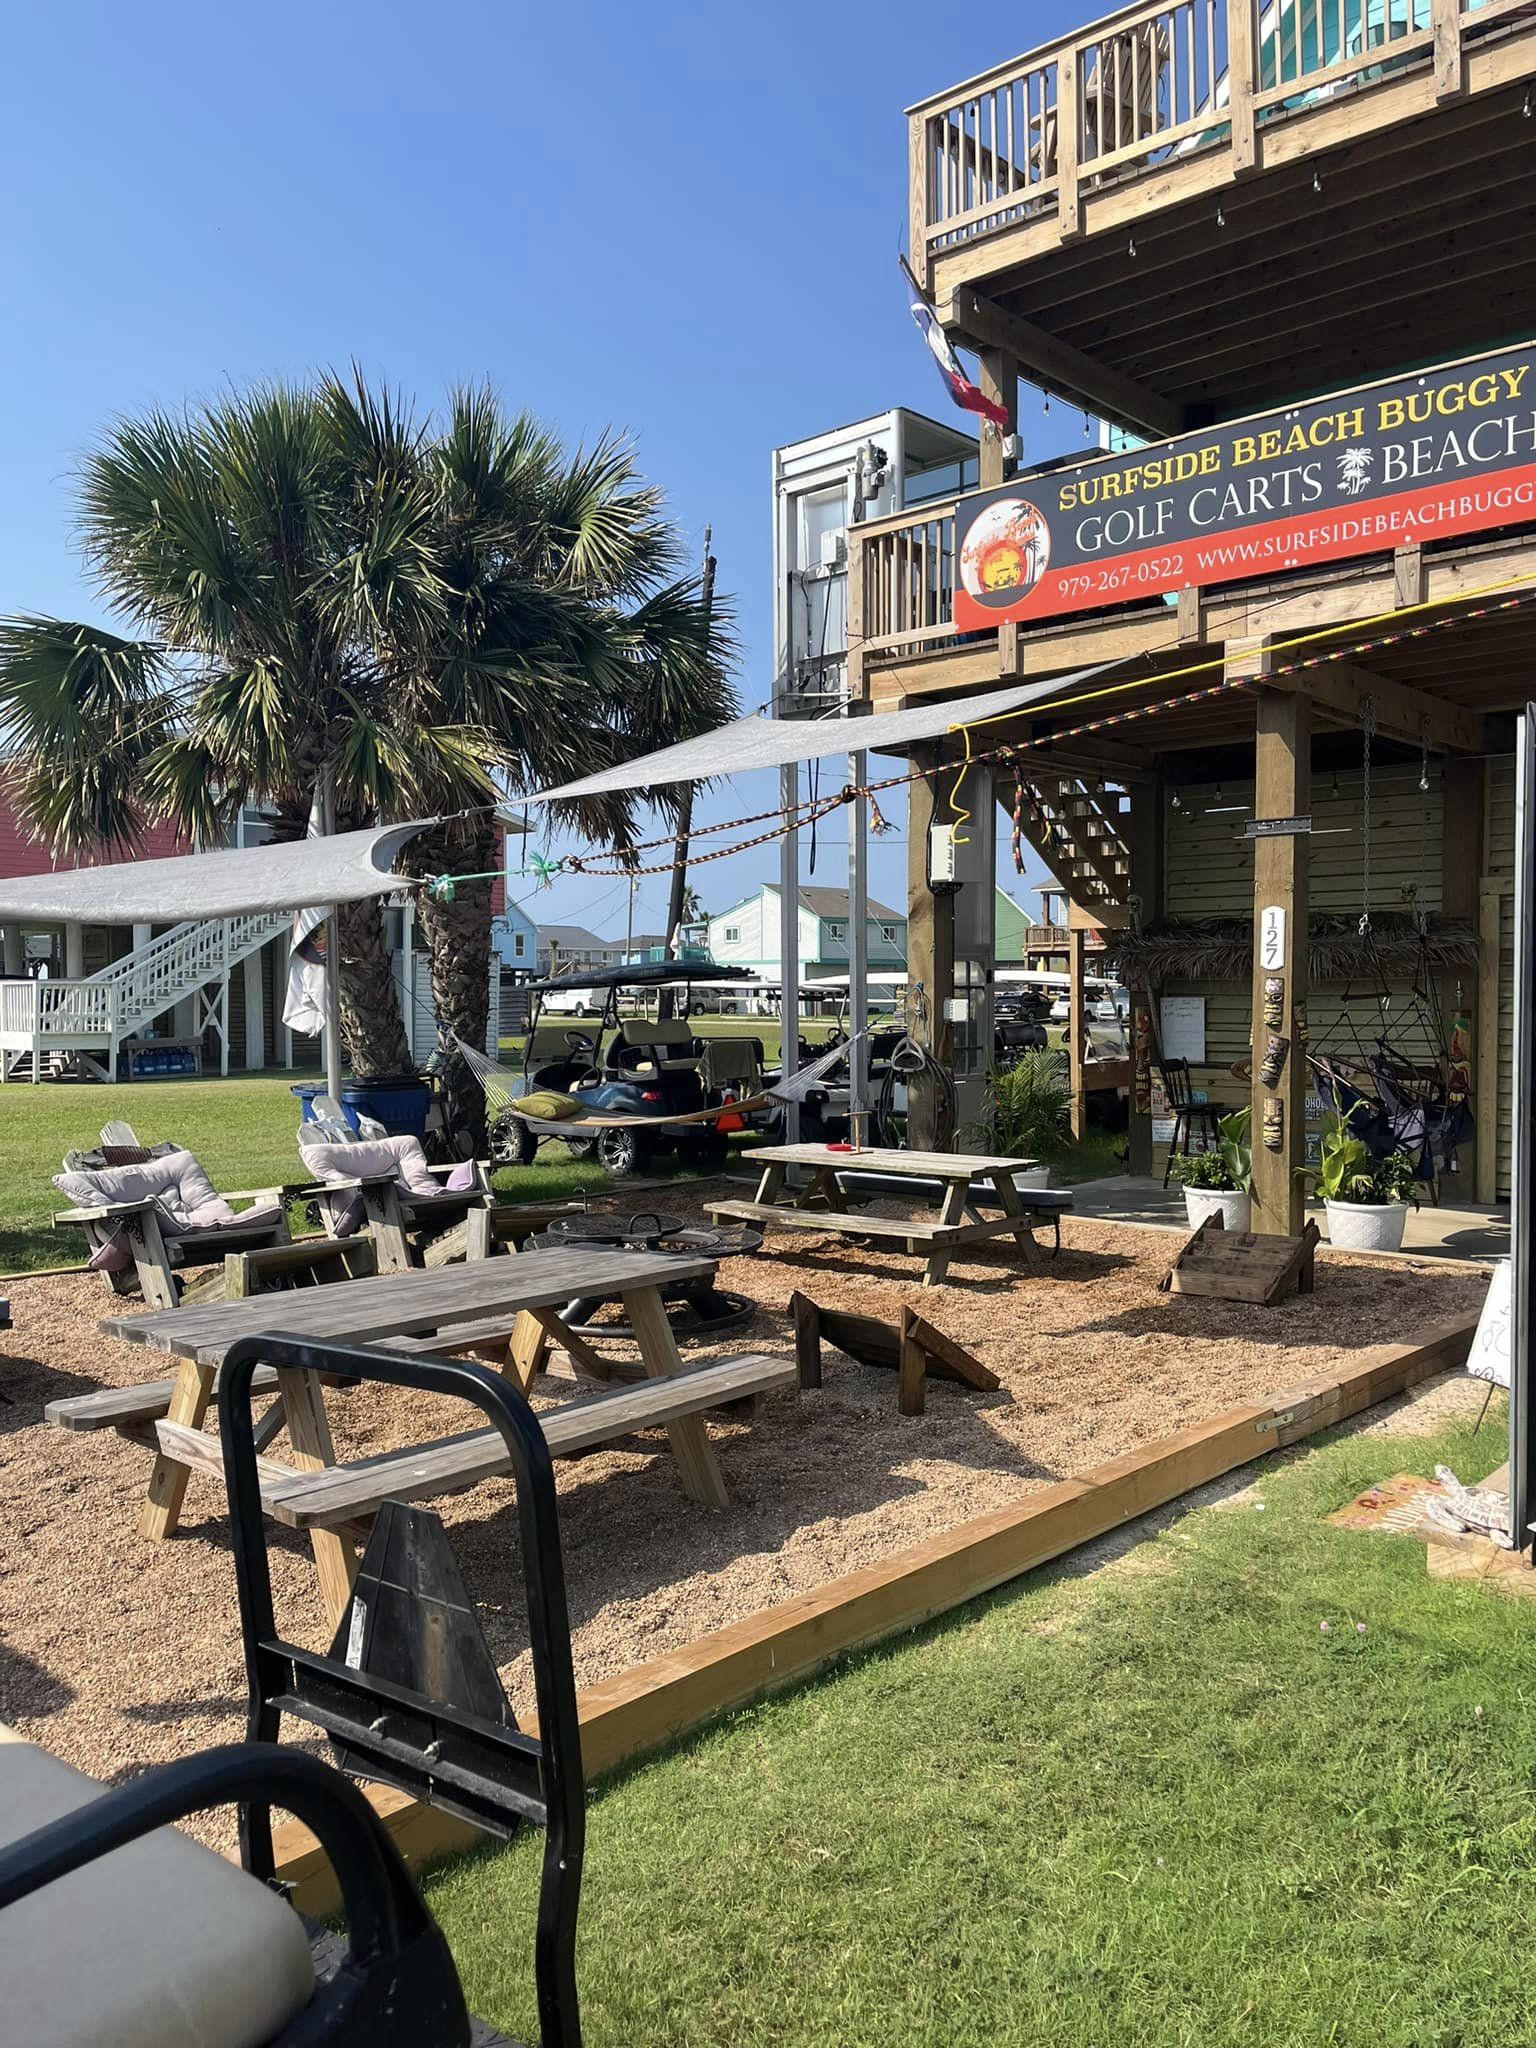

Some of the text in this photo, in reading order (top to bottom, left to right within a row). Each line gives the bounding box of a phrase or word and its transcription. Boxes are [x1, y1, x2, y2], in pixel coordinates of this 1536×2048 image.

[1059, 365, 1530, 511] SURFSIDE BEACH BUGGY
[1075, 410, 1536, 551] GOLF CARTS BEACH
[1058, 482, 1536, 598] 979-267-0522 WWW.SURFSIDEBEACHBUGG
[1265, 911, 1278, 966] 127
